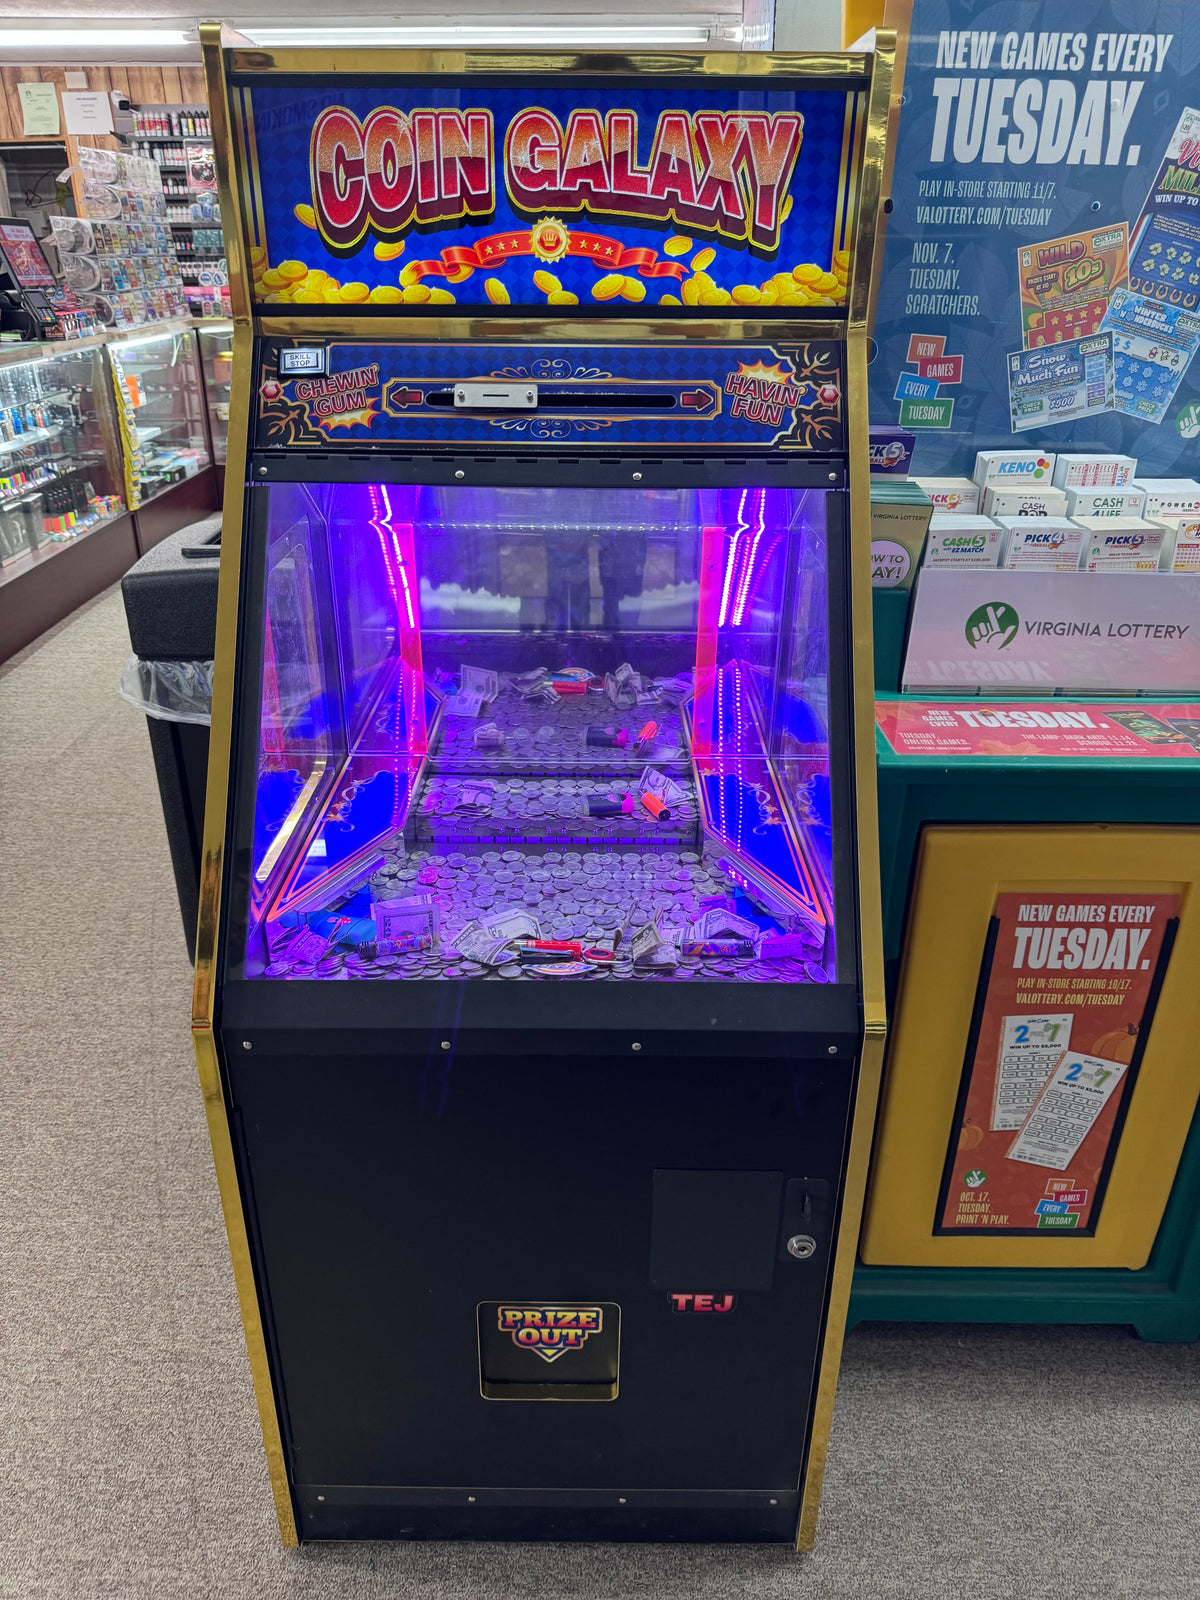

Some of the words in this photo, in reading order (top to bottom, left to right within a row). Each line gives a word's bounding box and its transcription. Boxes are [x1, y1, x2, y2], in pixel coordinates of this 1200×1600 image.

[936, 31, 997, 69] NEW
[1001, 31, 1088, 71] GAMES
[1091, 34, 1174, 72] EVERY
[930, 78, 1145, 165] TUESDAY.
[312, 107, 494, 245] COIN
[506, 108, 802, 247] GALAXY
[1158, 165, 1200, 195] MIL
[919, 180, 941, 197] PLAY
[943, 181, 984, 198] IN-STORE
[987, 182, 1031, 199] STARTING
[1032, 182, 1057, 202] 11/7.
[1155, 194, 1172, 203] WIN
[1174, 195, 1186, 203] UP
[1187, 196, 1199, 206] TO
[917, 206, 1052, 229] VALOTTERY.COM/TUESDAY
[912, 243, 939, 263] NOV.
[944, 243, 955, 264] 7.
[1037, 241, 1086, 269] WILD
[909, 269, 960, 290] TUESDAY.
[905, 295, 980, 316] SCRATCHERS.
[1135, 306, 1167, 322] WINTER
[917, 342, 936, 356] NEW
[1028, 353, 1066, 369] Snow
[927, 363, 953, 377] GAMES
[1017, 369, 1052, 386] Much
[1055, 364, 1078, 377] Fun
[905, 382, 929, 396] EVERY
[315, 391, 366, 416] GUM
[1049, 396, 1075, 409] $500
[733, 397, 782, 425] FUN
[909, 406, 945, 419] TUESDAY
[998, 461, 1036, 474] KENO
[928, 494, 949, 502] ICK
[1021, 502, 1046, 510] CASH
[1093, 497, 1124, 508] CASH
[1024, 533, 1051, 543] PICK
[1105, 536, 1132, 545] PICK
[889, 554, 904, 563] TO
[871, 566, 901, 579] AY!
[1024, 621, 1101, 637] VIRGINIA
[1107, 623, 1190, 639] LOTTERY
[954, 710, 1111, 729] TUESDAY.
[1018, 904, 1054, 922] NEW
[1055, 904, 1105, 922] GAMES
[1108, 905, 1156, 923] EVERY
[1012, 927, 1152, 970] TUESDAY.
[1017, 978, 1035, 989] PLAY
[1036, 978, 1070, 989] IN-STORE
[1071, 979, 1106, 990] STARTING
[1015, 992, 1125, 1007] VALOTTERY.COM/TUESDAY
[1014, 1025, 1030, 1044] 2
[1065, 1063, 1083, 1081] 2
[1052, 1182, 1067, 1191] NEW
[960, 1192, 976, 1202] OCT.
[977, 1192, 990, 1202] 17.
[1059, 1194, 1081, 1202] GAMES
[958, 1203, 991, 1213] TUESDAY.
[1042, 1204, 1061, 1213] EVERY
[956, 1215, 979, 1224] PRINT
[991, 1215, 1010, 1225] PLAY.
[1045, 1216, 1073, 1225] TUESDAY
[671, 1293, 734, 1312] TEJ
[502, 1309, 598, 1329] PRIZE
[517, 1328, 583, 1347] OUT
